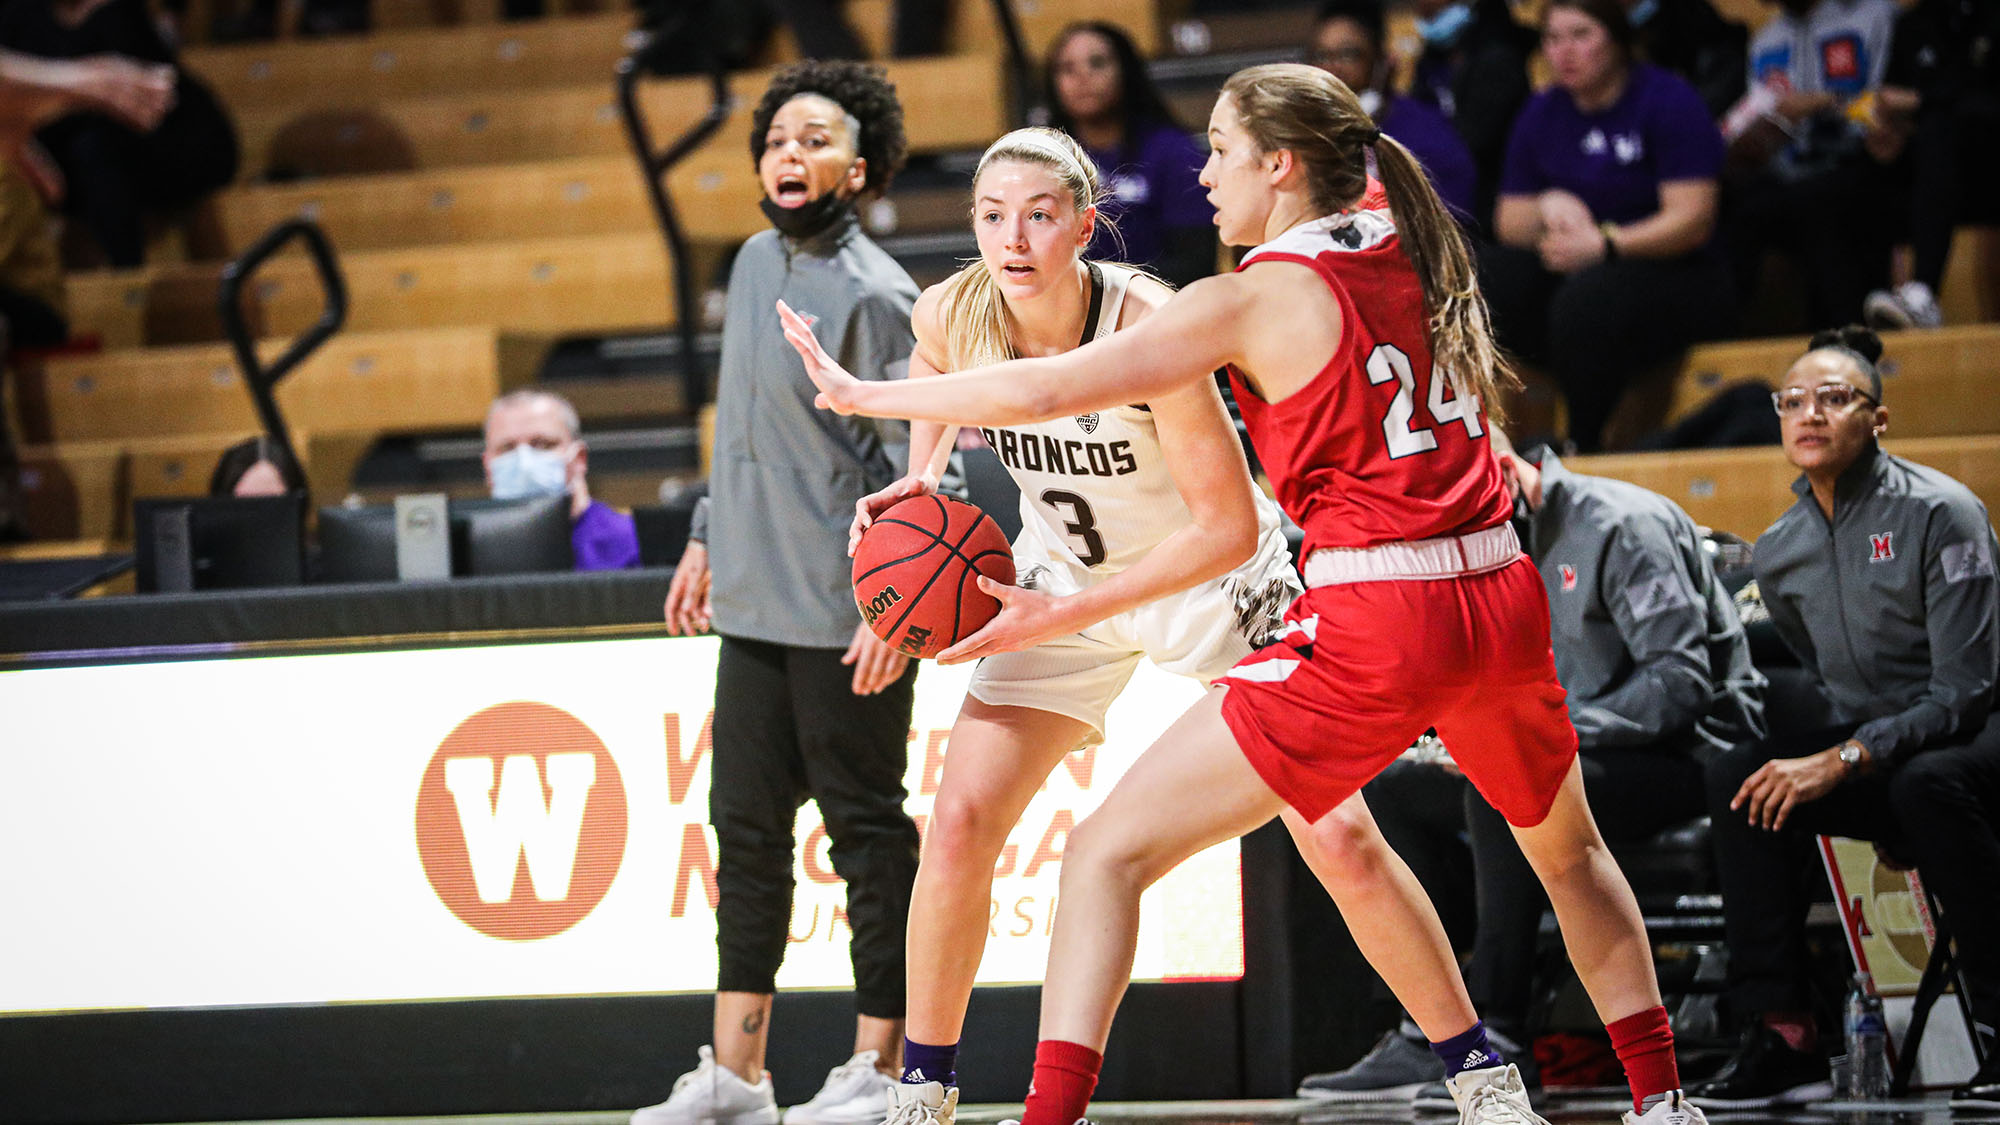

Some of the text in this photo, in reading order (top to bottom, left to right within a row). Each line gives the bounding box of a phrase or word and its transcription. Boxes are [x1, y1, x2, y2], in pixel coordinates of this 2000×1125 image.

[1366, 342, 1486, 460] 24
[1040, 487, 1108, 569] 3
[1869, 531, 1896, 564] M
[444, 751, 598, 904] W
